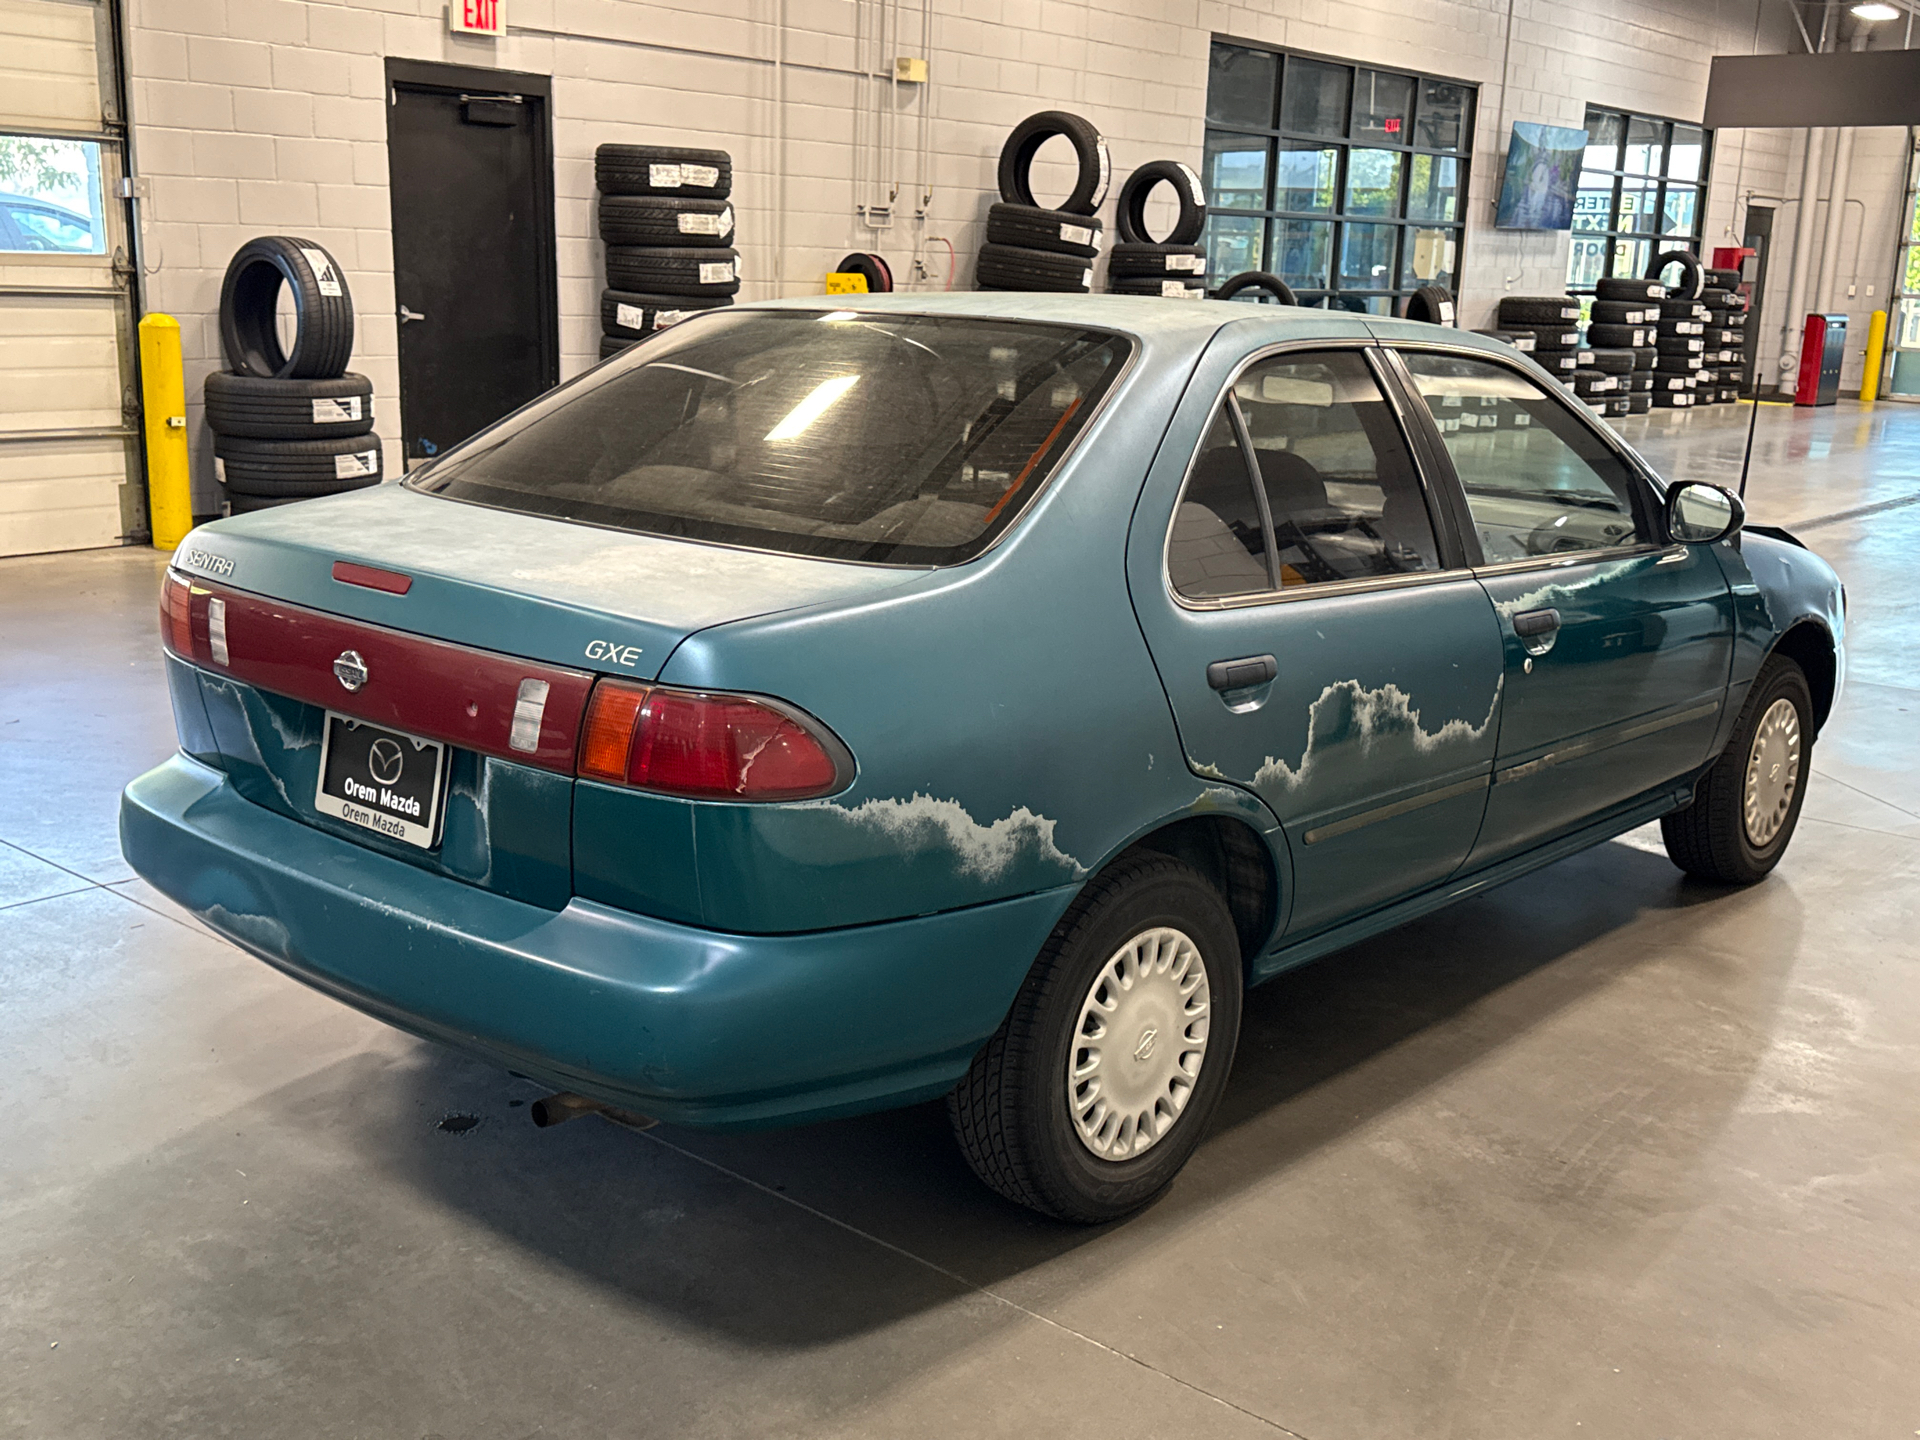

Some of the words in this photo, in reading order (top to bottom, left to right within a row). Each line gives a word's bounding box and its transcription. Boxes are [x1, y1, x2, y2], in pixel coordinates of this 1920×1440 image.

[463, 0, 498, 31] EXIT
[1385, 118, 1401, 133] EXIT
[186, 549, 236, 577] SENTRA
[584, 639, 643, 667] GXE
[344, 777, 377, 803] Orem
[380, 787, 420, 817] Mazda
[342, 803, 370, 825] Orem
[372, 812, 405, 837] Mazda
